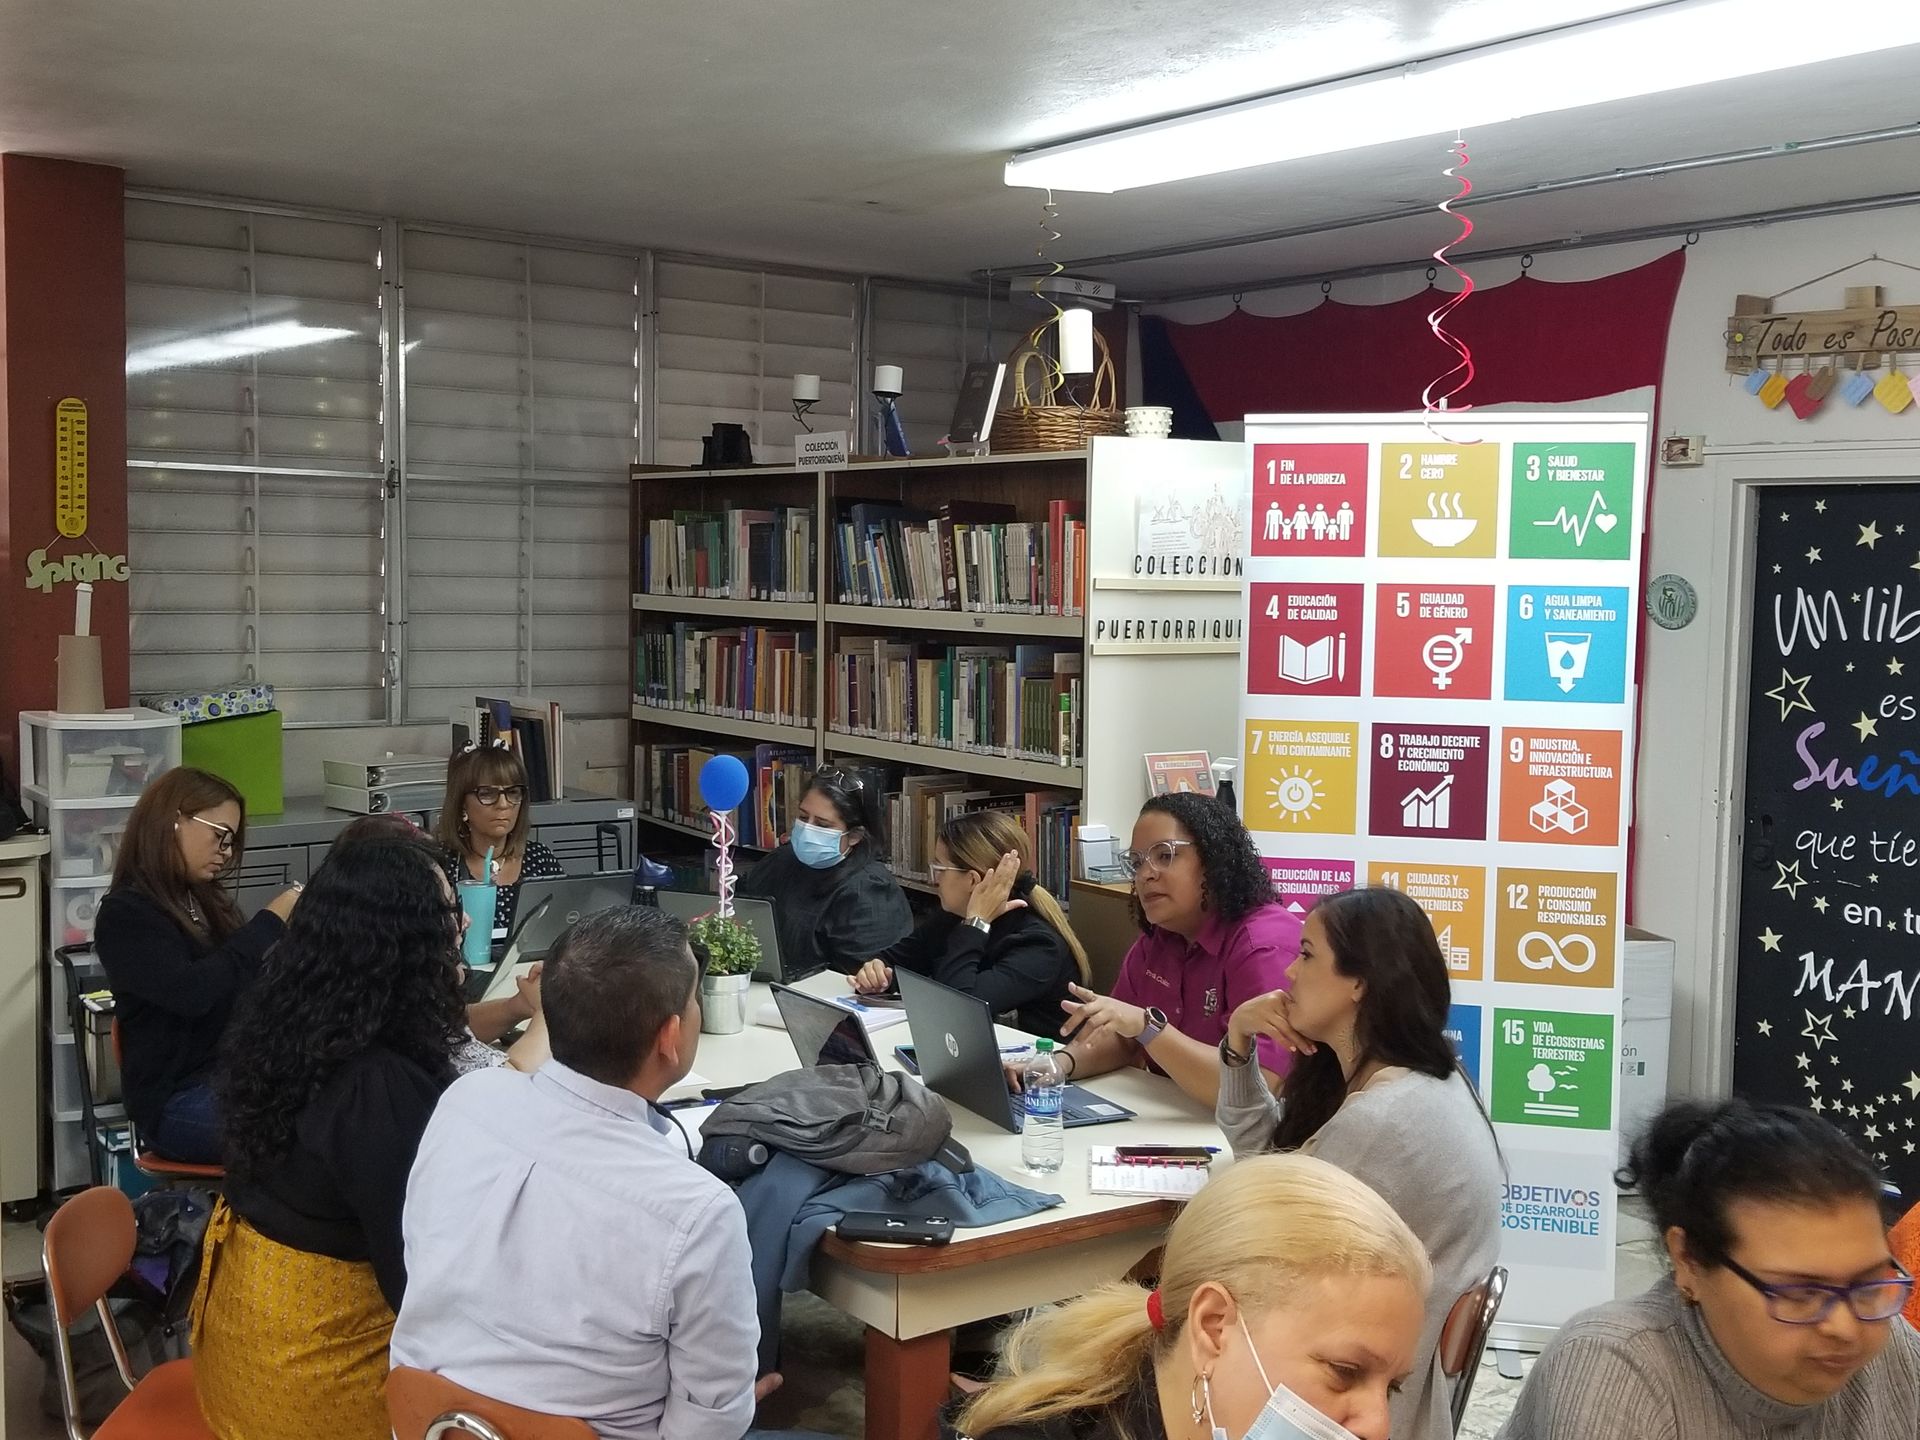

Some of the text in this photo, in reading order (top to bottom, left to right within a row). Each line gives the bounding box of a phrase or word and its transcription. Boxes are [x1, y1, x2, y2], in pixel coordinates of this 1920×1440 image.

[1756, 317, 1807, 353] Todo
[1824, 330, 1855, 349] es
[1280, 460, 1295, 471] FIN
[1399, 453, 1412, 480] 2
[1420, 453, 1458, 466] HAMBRE
[1547, 455, 1578, 468] SALUD
[1266, 460, 1276, 485] 1
[1420, 467, 1444, 480] CERO
[1526, 454, 1540, 482] 3
[1547, 469, 1605, 482] Y BIENESTAR
[1280, 473, 1346, 485] DE LA POBREZA
[1134, 552, 1243, 576] COLECCIÓN
[1287, 594, 1337, 607] EDUCACIÓN
[1396, 592, 1410, 618] 5
[1420, 592, 1465, 605] IGUALDAD
[1544, 594, 1603, 608] AGUA LIMPIA
[1265, 594, 1280, 620] 4
[1287, 608, 1338, 621] DE CALIDAD
[1419, 605, 1468, 619] DE GÉNERO
[1519, 594, 1533, 620] 6
[1544, 608, 1616, 621] Y SANEAMIENTO
[1879, 694, 1917, 721] es
[1251, 731, 1263, 755] 7
[1268, 730, 1351, 745] ENERGÍA ASEQUIBLE
[1399, 734, 1481, 748] TRABAJO DECENTE
[1268, 744, 1352, 757] Y NO CONTAMINANTE
[1379, 733, 1394, 759] 8
[1509, 737, 1524, 763] 9
[1399, 748, 1465, 760] Y CRECIMIENTO
[1529, 751, 1592, 765] INNOVACIÓN E
[1398, 759, 1449, 773] ECONÓMICO
[1529, 764, 1613, 779] INFRAESTRUCTURA
[1796, 830, 1856, 869] que
[1271, 868, 1351, 883] REDUCCIÓN DE LAS
[1381, 871, 1399, 890] 11
[1407, 872, 1459, 885] CIUDADES Y
[1406, 885, 1469, 899] COMUNIDADES
[1506, 883, 1529, 910] 12
[1538, 884, 1596, 900] PRODUCCIÓN
[1412, 899, 1463, 912] STENIBLES
[1538, 899, 1592, 912] Y CONSUMO
[1537, 911, 1607, 926] RESPONSABLES
[1844, 902, 1882, 928] en
[1793, 951, 1920, 1021] MAN
[1502, 1019, 1525, 1045] 15
[1533, 1021, 1554, 1034] VIDA
[1532, 1034, 1544, 1046] DE
[1545, 1035, 1605, 1050] ECOSISTEMAS
[1532, 1047, 1586, 1062] TERRESTRES
[1516, 1203, 1599, 1220] DESARROLLO
